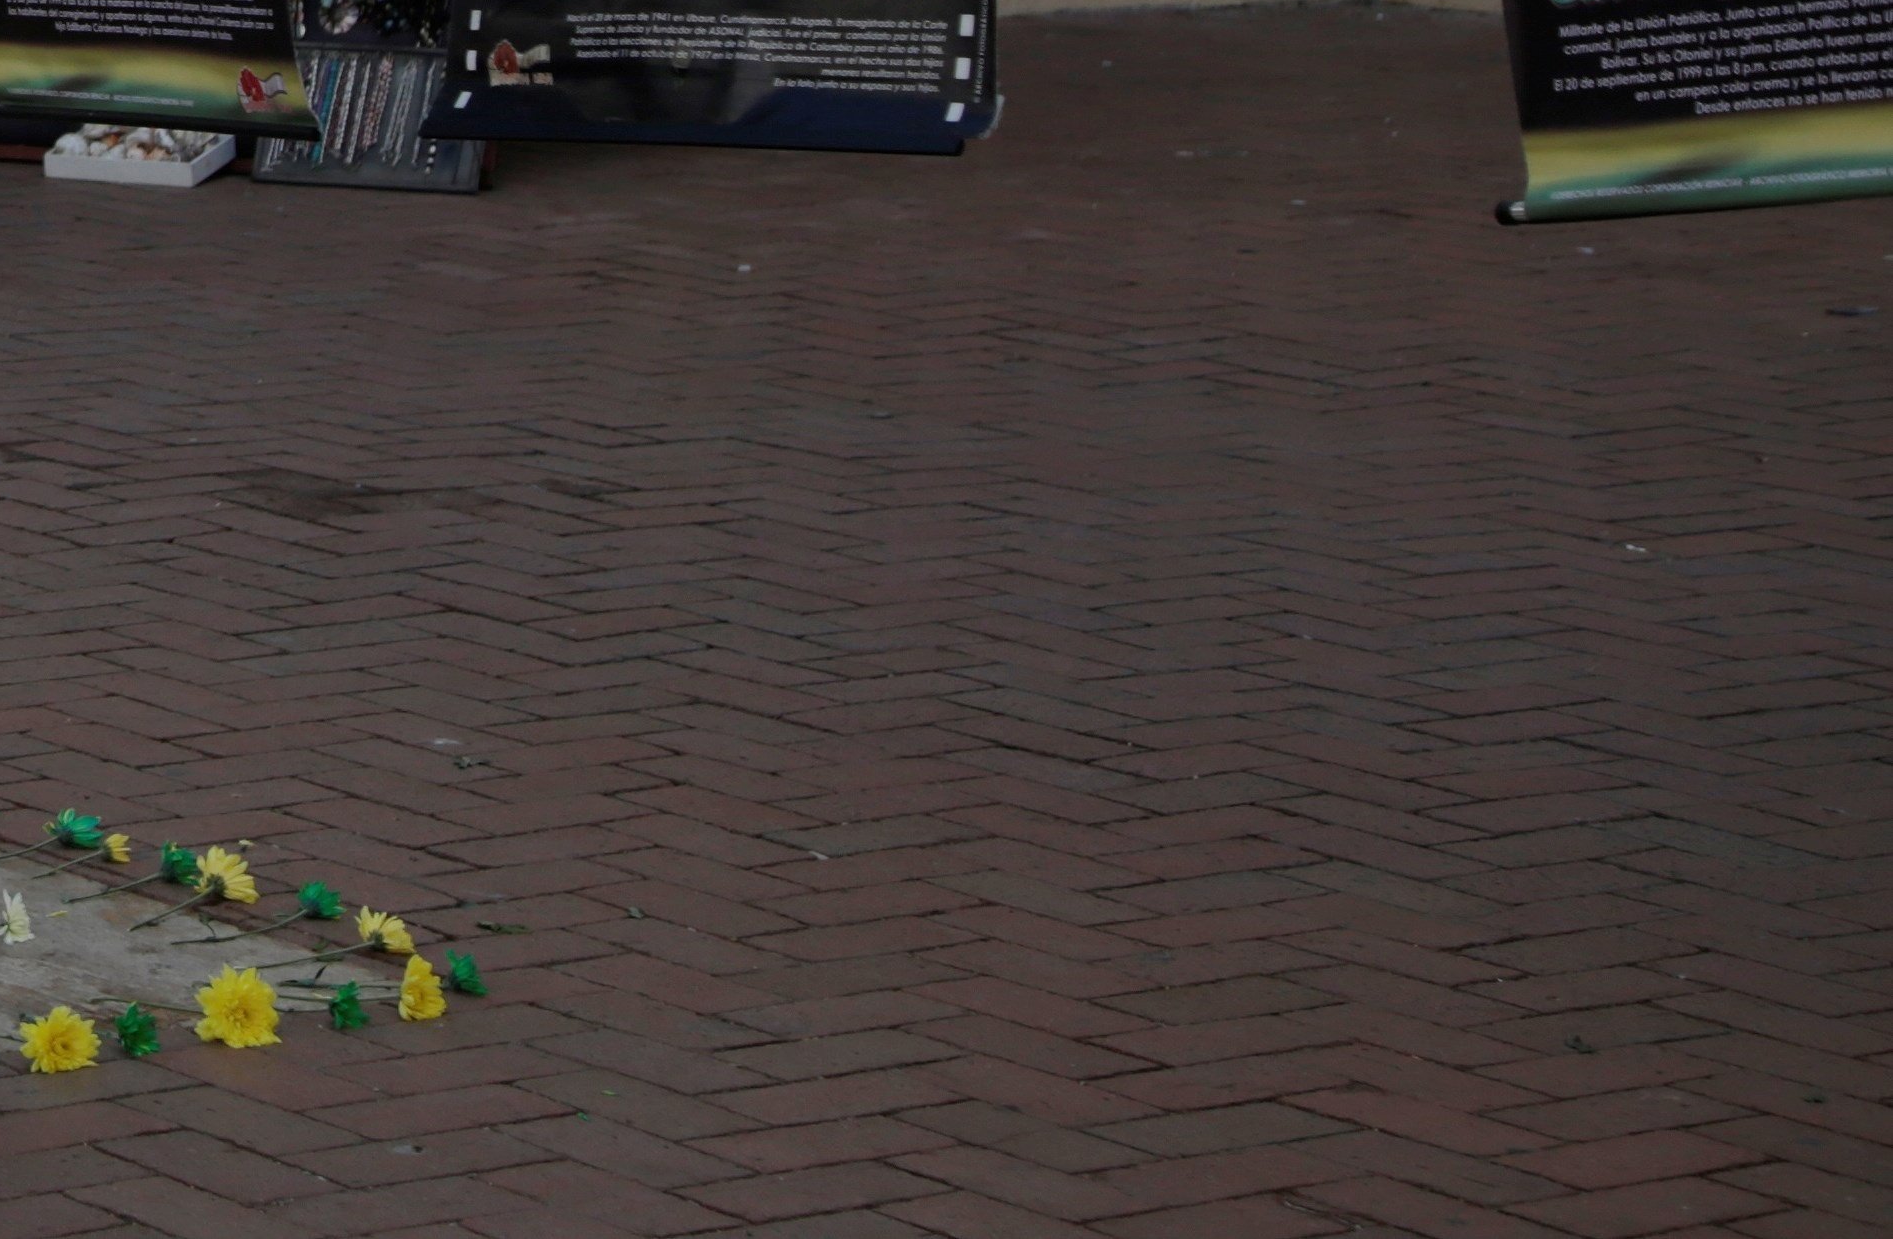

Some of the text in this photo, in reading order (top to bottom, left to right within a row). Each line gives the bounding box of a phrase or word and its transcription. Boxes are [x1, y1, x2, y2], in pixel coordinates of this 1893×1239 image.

[1725, 5, 1755, 20] Junto
[1757, 5, 1780, 17] con
[1731, 18, 1805, 41] organización
[1851, 11, 1868, 25] de
